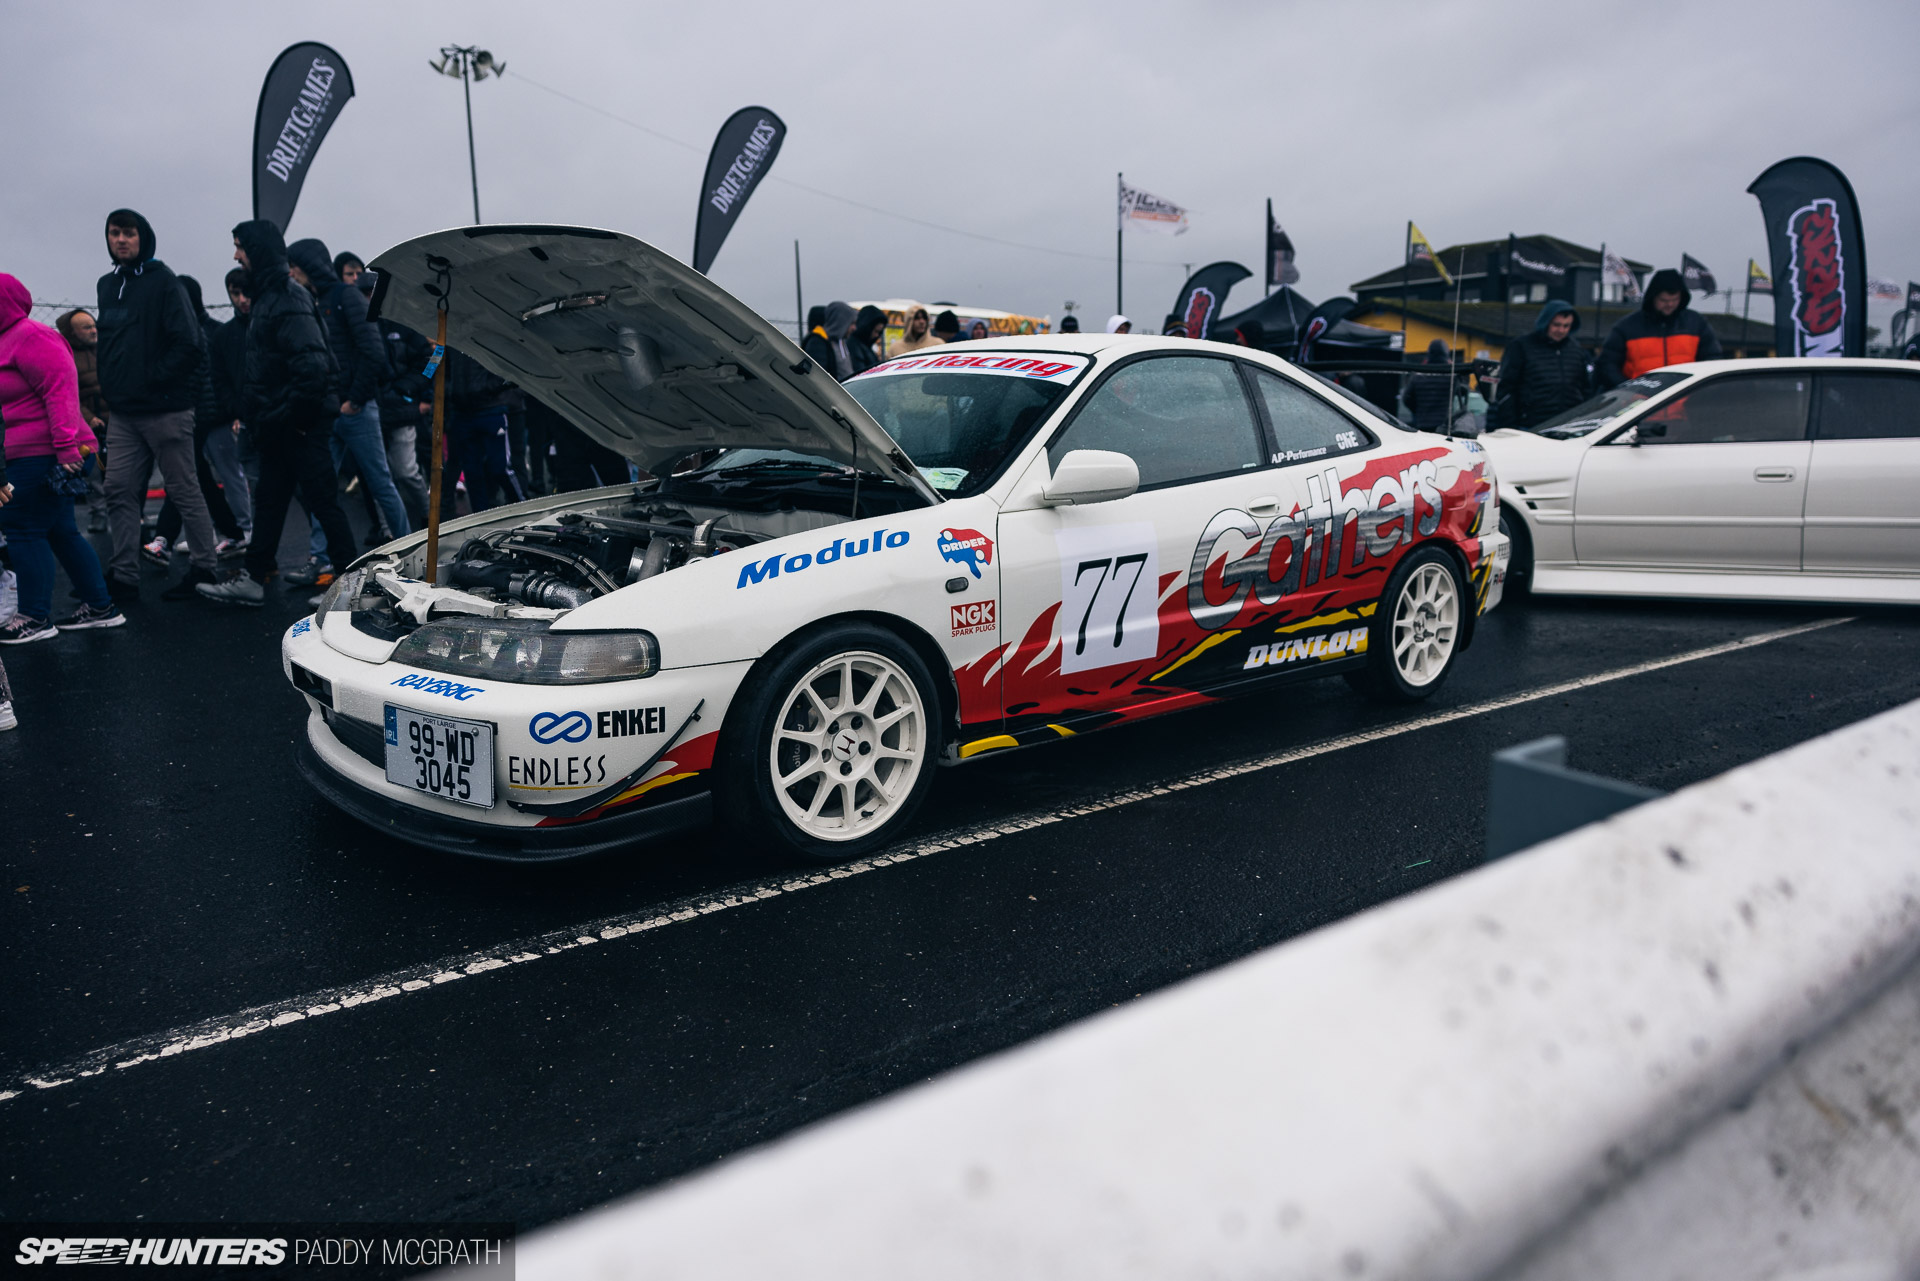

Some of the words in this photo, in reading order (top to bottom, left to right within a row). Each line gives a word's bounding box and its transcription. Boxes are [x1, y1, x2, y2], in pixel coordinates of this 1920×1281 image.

[266, 58, 335, 182] DRIFTGAMES
[711, 119, 776, 214] DRIFTGAMES
[923, 355, 1078, 378] Racing
[1271, 446, 1327, 464] AP-Performance
[736, 528, 910, 590] Modulo
[941, 537, 986, 553] DRIDER
[1188, 459, 1443, 631] Gathers
[952, 602, 994, 628] NGK
[1074, 553, 1149, 656] 77
[951, 629, 974, 638] SPARK
[975, 623, 996, 633] PLUGS
[1243, 627, 1368, 670] DUNLOP
[390, 674, 485, 701] RAYBRIG
[423, 716, 437, 726] PORT
[597, 706, 665, 739] ENKEI
[409, 720, 475, 767] 99-WD
[415, 756, 471, 800] 3045
[509, 754, 606, 786] ENDLESS
